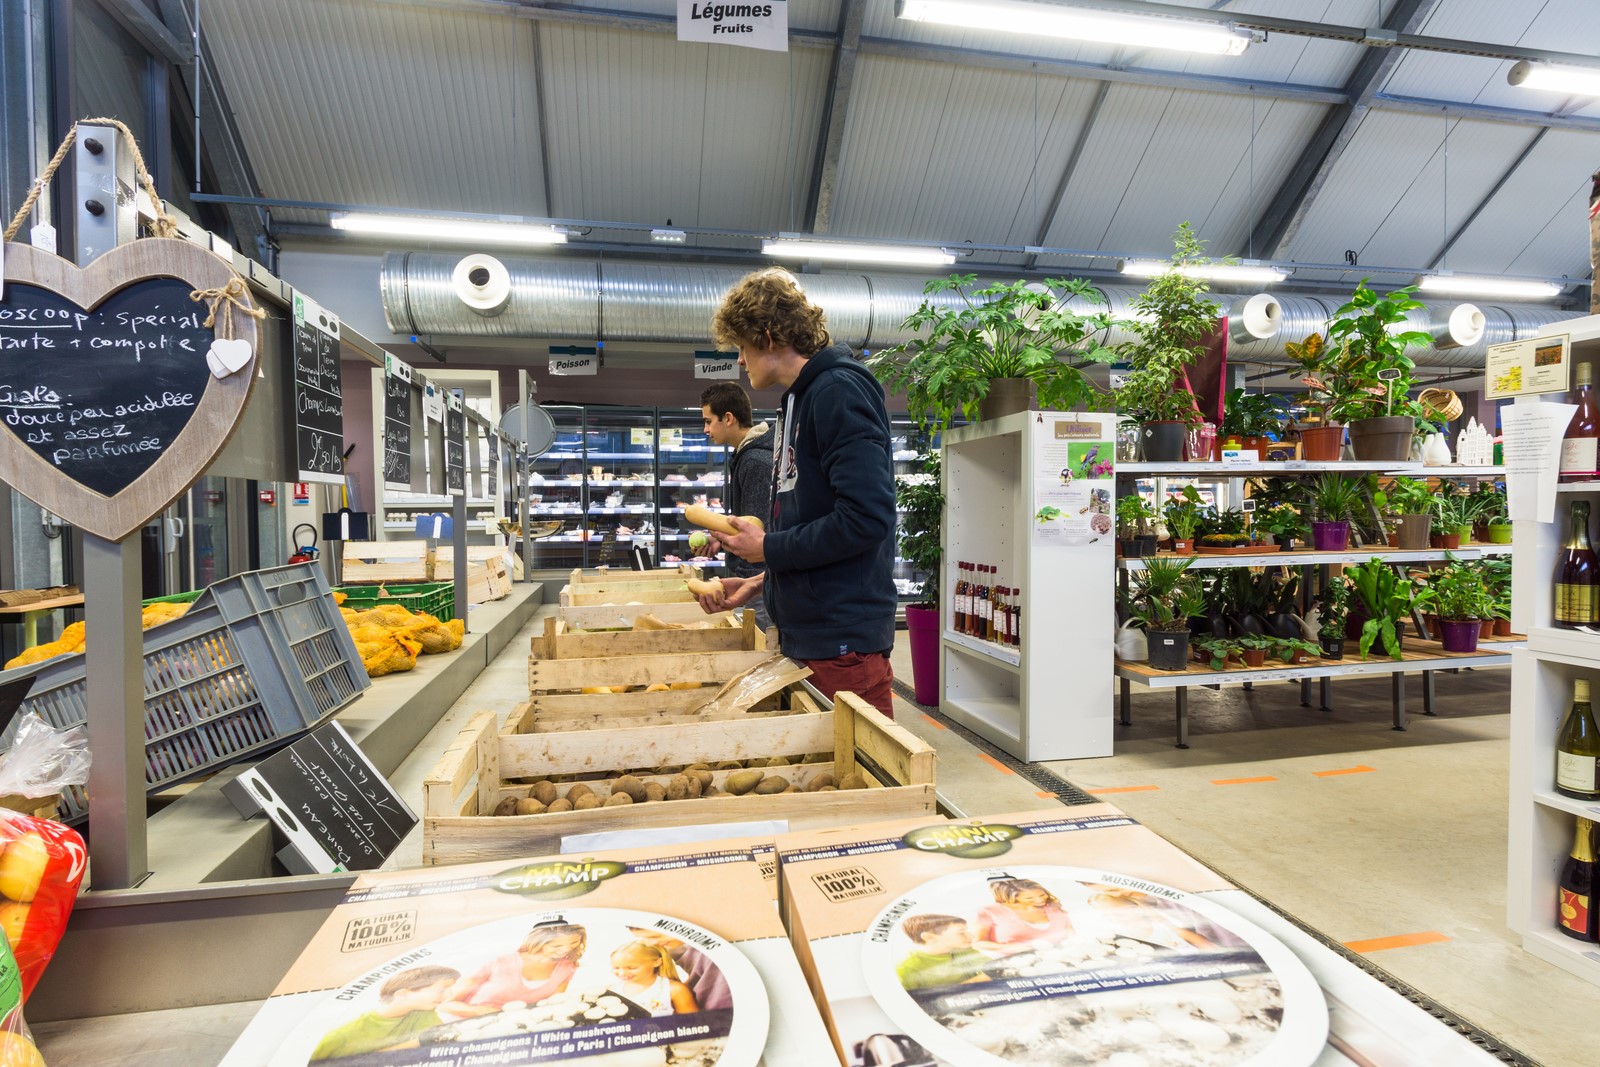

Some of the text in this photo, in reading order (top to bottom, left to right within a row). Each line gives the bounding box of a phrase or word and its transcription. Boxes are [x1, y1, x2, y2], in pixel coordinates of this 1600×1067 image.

[690, 2, 772, 21] Légumes
[713, 24, 753, 34] Fruits
[556, 358, 590, 370] Poisson
[702, 362, 732, 374] Viande
[6, 409, 65, 425] douce
[847, 843, 897, 855] MUSHROOMS
[915, 829, 1011, 851] CHAMP
[697, 855, 748, 866] MUSHROOMS
[499, 867, 610, 891] CHAMP
[817, 868, 865, 882] NATURAL
[823, 875, 875, 893] 100%
[832, 886, 882, 901] NATUURLIJK
[1101, 873, 1185, 901] MUSHROOMS
[353, 912, 409, 928] NATURAL
[871, 899, 917, 943] CHAMPIGNONS
[351, 920, 411, 941] 100%
[653, 918, 721, 952] MUSHROOMS
[348, 932, 411, 950] NATUURLIJK
[336, 948, 432, 1001] CHAMPIGNONS
[430, 1024, 631, 1058] Witte champignons White mushrooms
[464, 1049, 529, 1066] Champignon
[531, 1045, 560, 1058] blanc
[562, 1043, 575, 1054] de
[577, 1038, 605, 1051] Paris
[614, 1031, 675, 1048] Champignon
